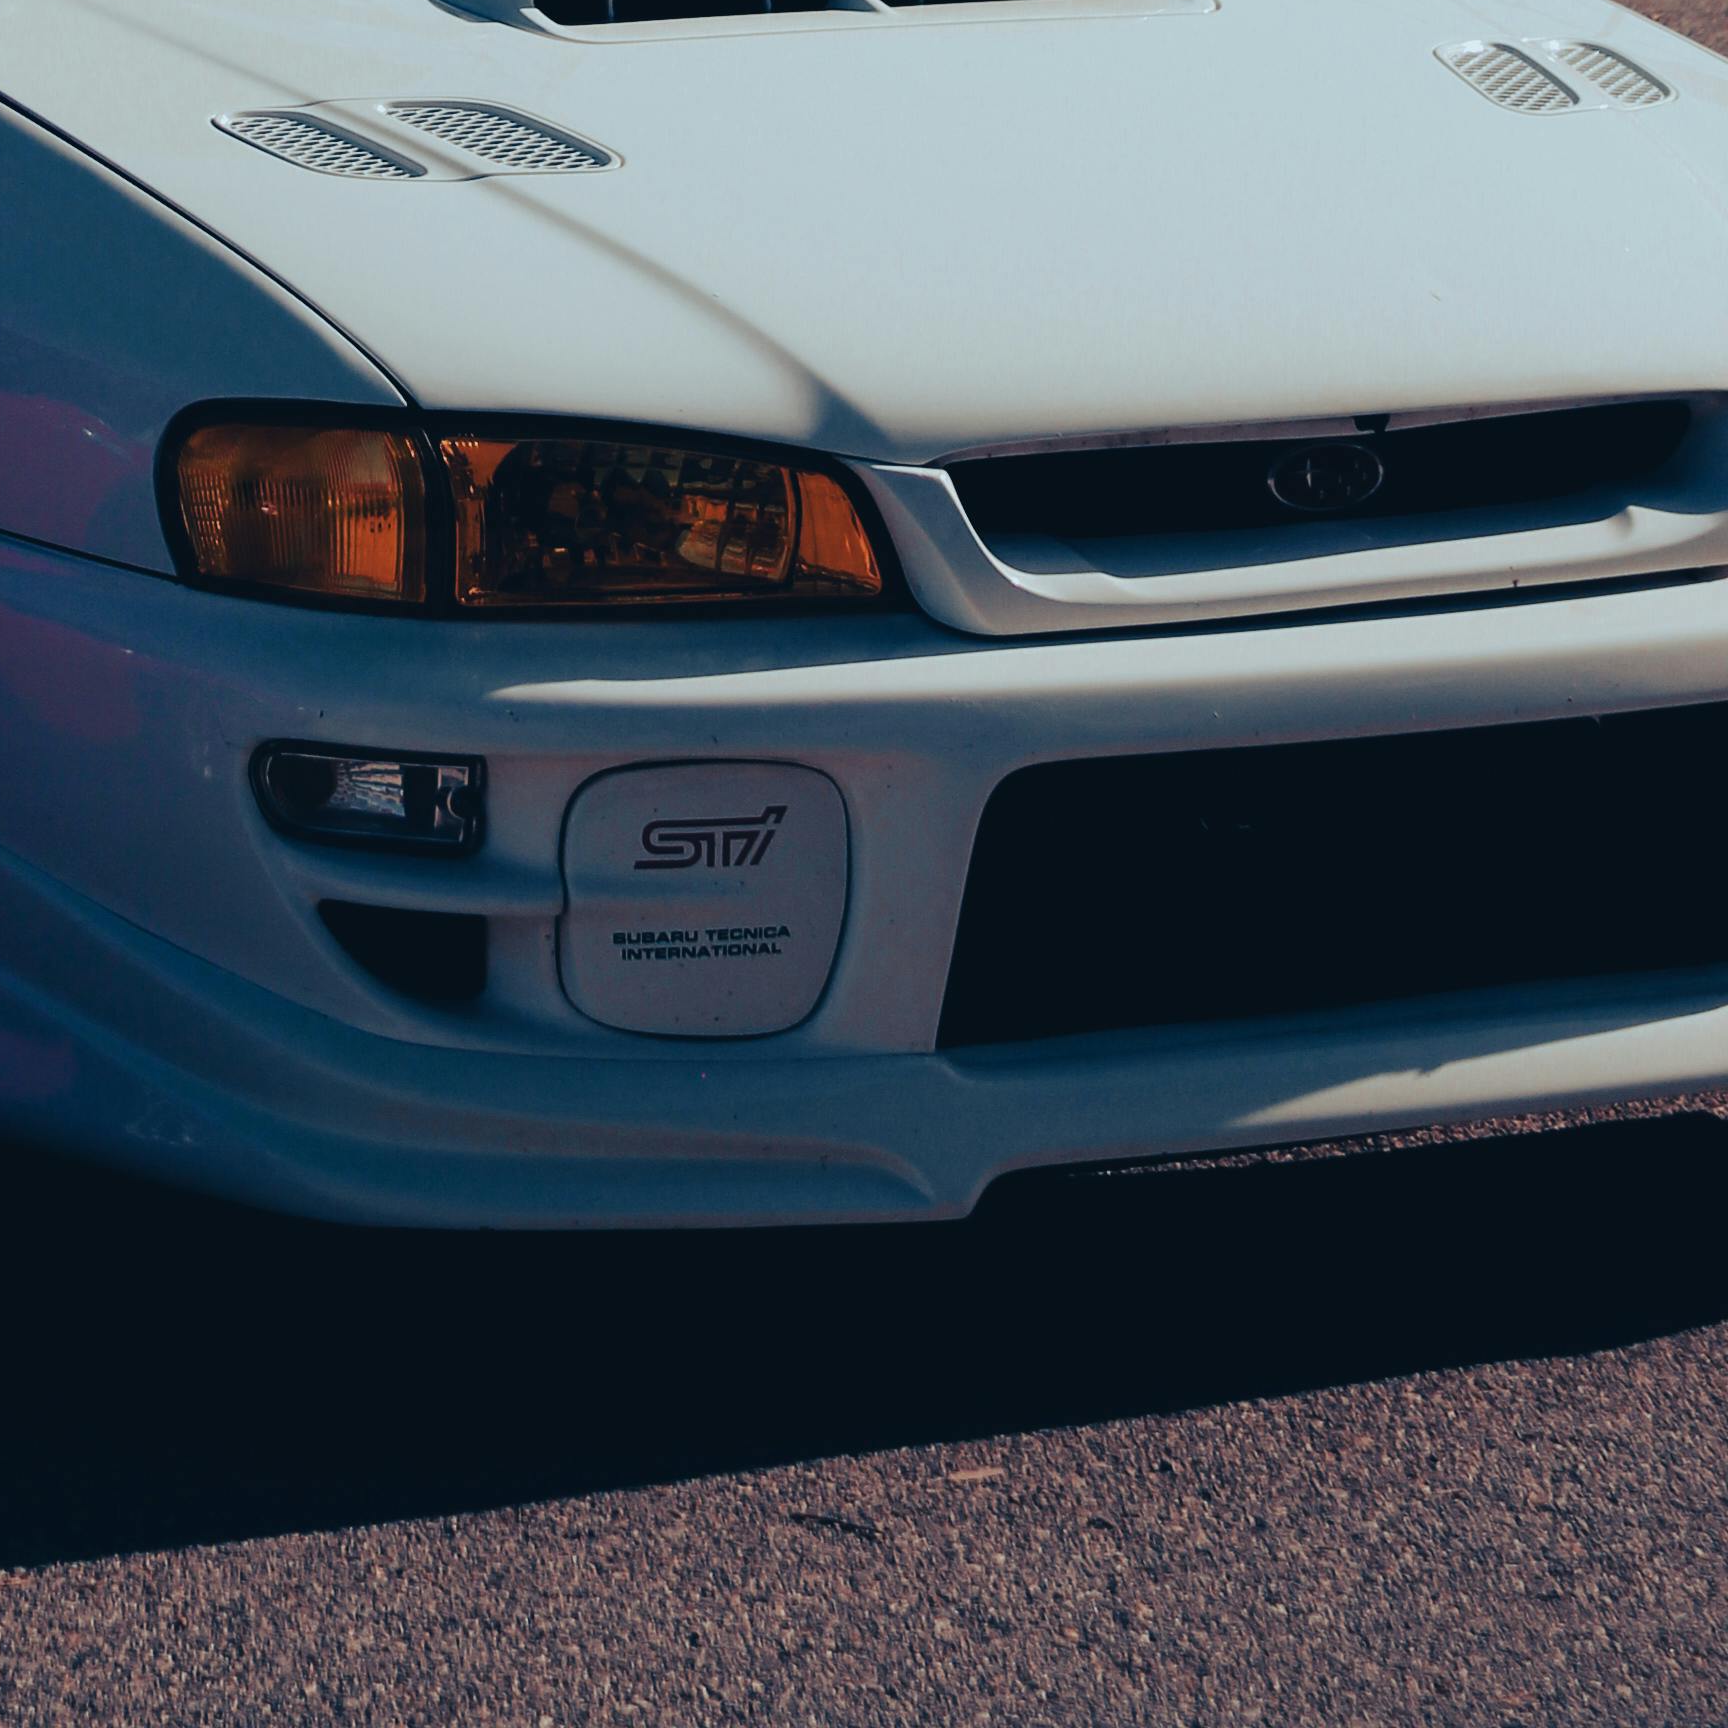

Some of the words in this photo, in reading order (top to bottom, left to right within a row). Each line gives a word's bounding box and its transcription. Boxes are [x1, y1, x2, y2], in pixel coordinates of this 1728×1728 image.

[613, 928, 700, 945] SUBARU
[706, 926, 791, 941] TECNICA
[621, 942, 782, 960] INTERNATIONAL
